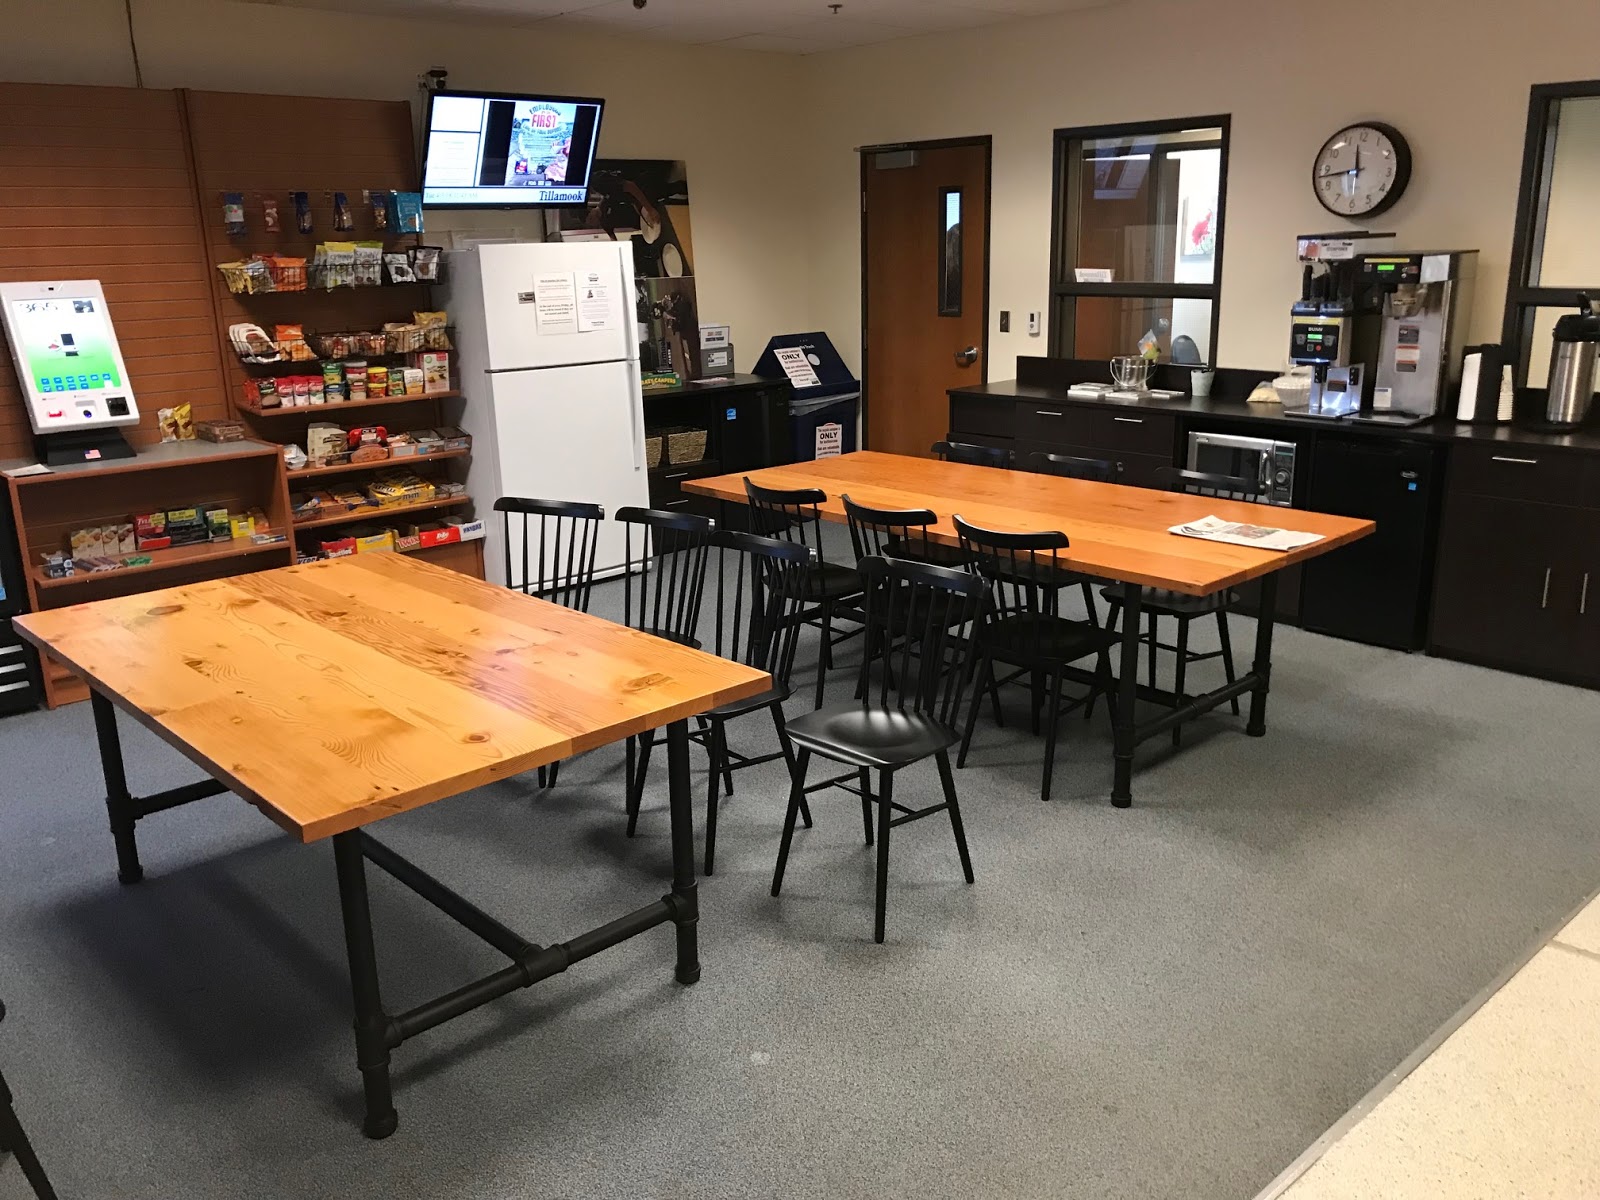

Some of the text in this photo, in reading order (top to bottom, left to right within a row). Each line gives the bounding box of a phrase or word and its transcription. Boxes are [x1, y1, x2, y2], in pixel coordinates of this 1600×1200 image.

[532, 114, 557, 128] FIRST
[1344, 136, 1352, 147] 11
[1359, 132, 1369, 142] 12
[1376, 137, 1381, 147] 1
[1329, 148, 1339, 159] 10
[1384, 149, 1391, 160] 2
[1324, 165, 1331, 173] 9
[1385, 168, 1392, 177] 3
[1325, 181, 1331, 190] 8
[1379, 183, 1386, 192] 4
[539, 190, 583, 201] Tillamook
[1334, 194, 1341, 202] 7
[1365, 195, 1372, 205] 5
[1349, 198, 1355, 208] 6
[819, 432, 838, 440] ONLY
